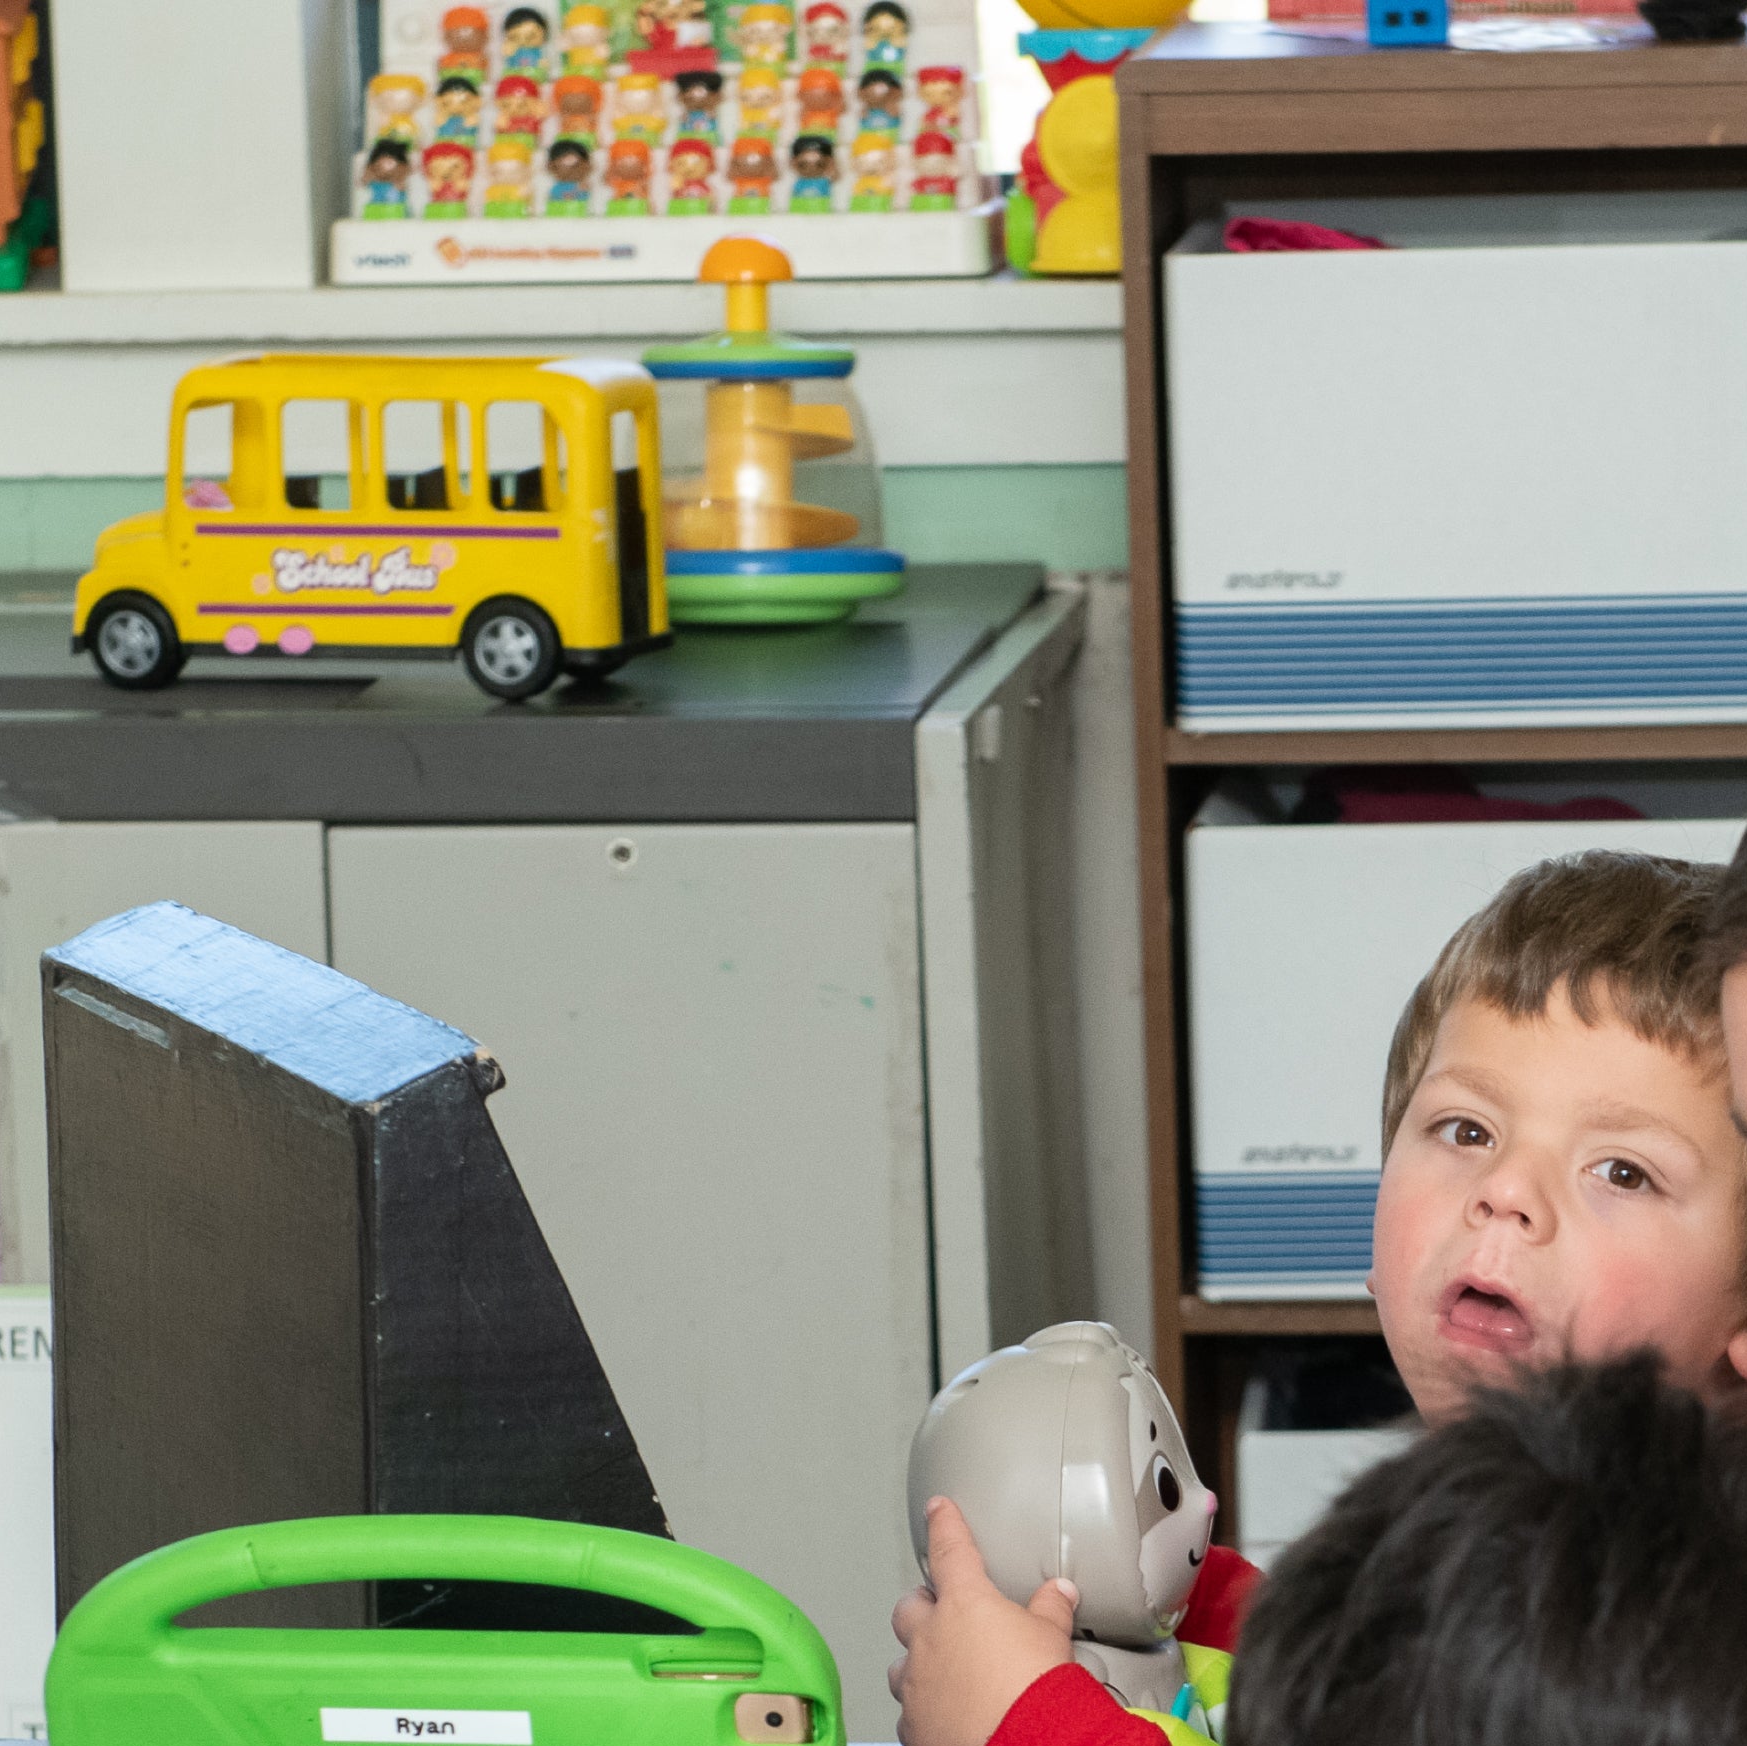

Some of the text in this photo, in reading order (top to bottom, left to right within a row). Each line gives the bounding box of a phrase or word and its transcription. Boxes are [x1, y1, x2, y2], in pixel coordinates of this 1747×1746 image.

[271, 545, 438, 595] School Bus
[396, 1717, 456, 1736] Ryan
